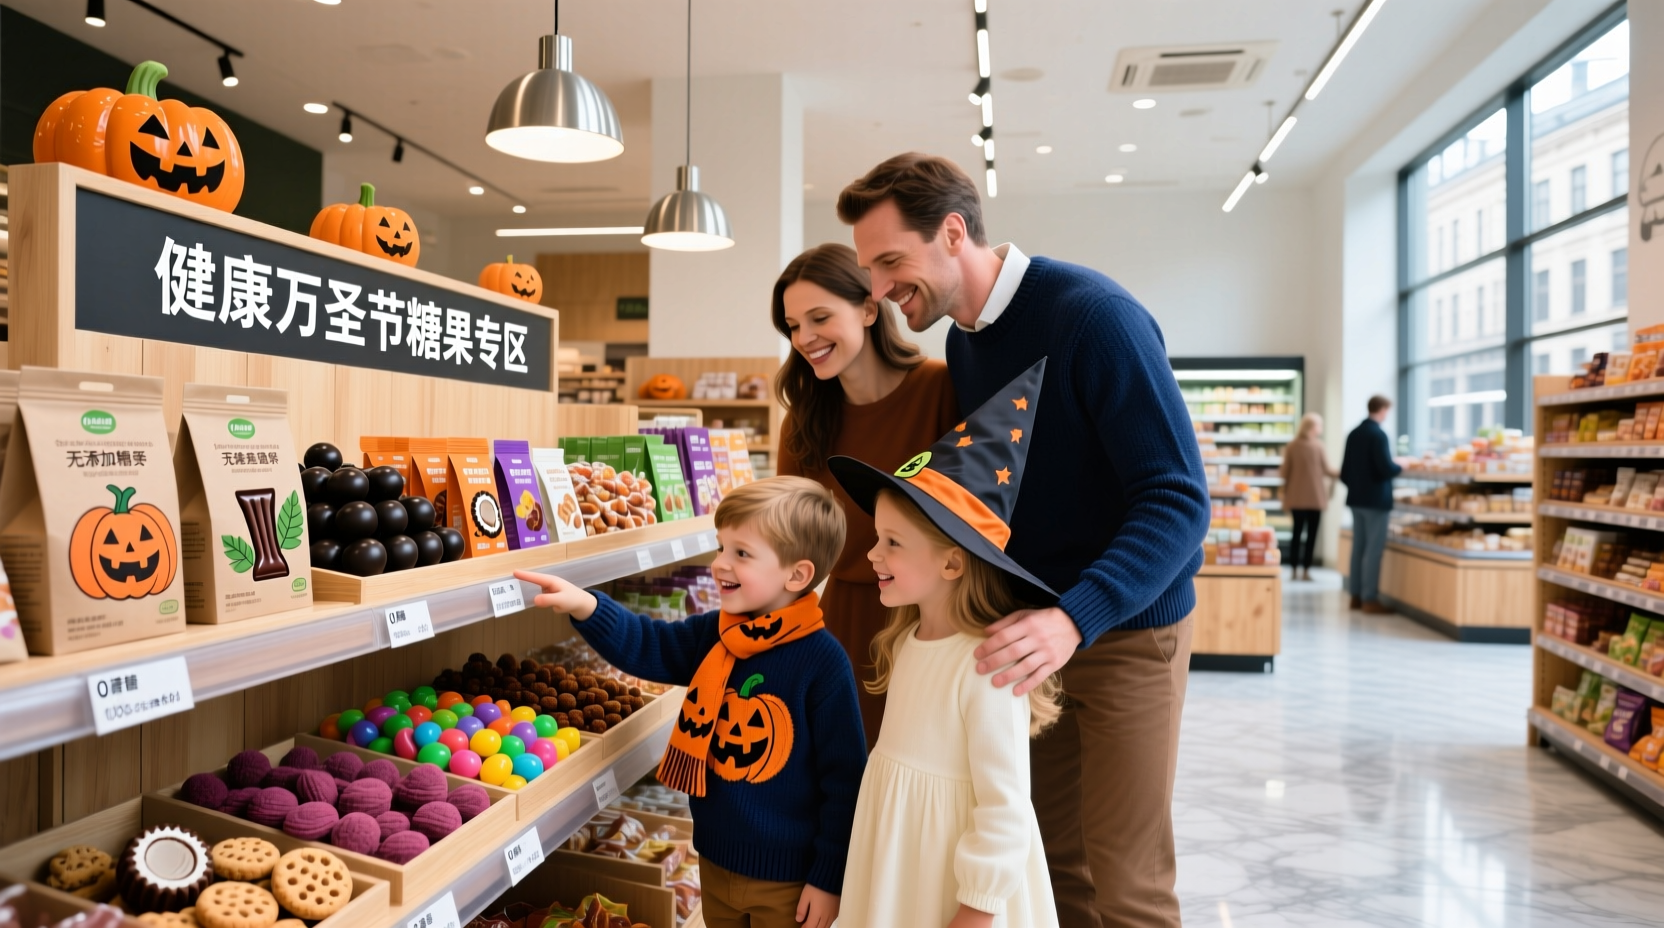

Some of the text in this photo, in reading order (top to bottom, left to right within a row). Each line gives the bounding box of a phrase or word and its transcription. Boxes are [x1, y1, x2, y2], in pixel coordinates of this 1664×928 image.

[154, 236, 528, 374] 健康万圣节糖果专区
